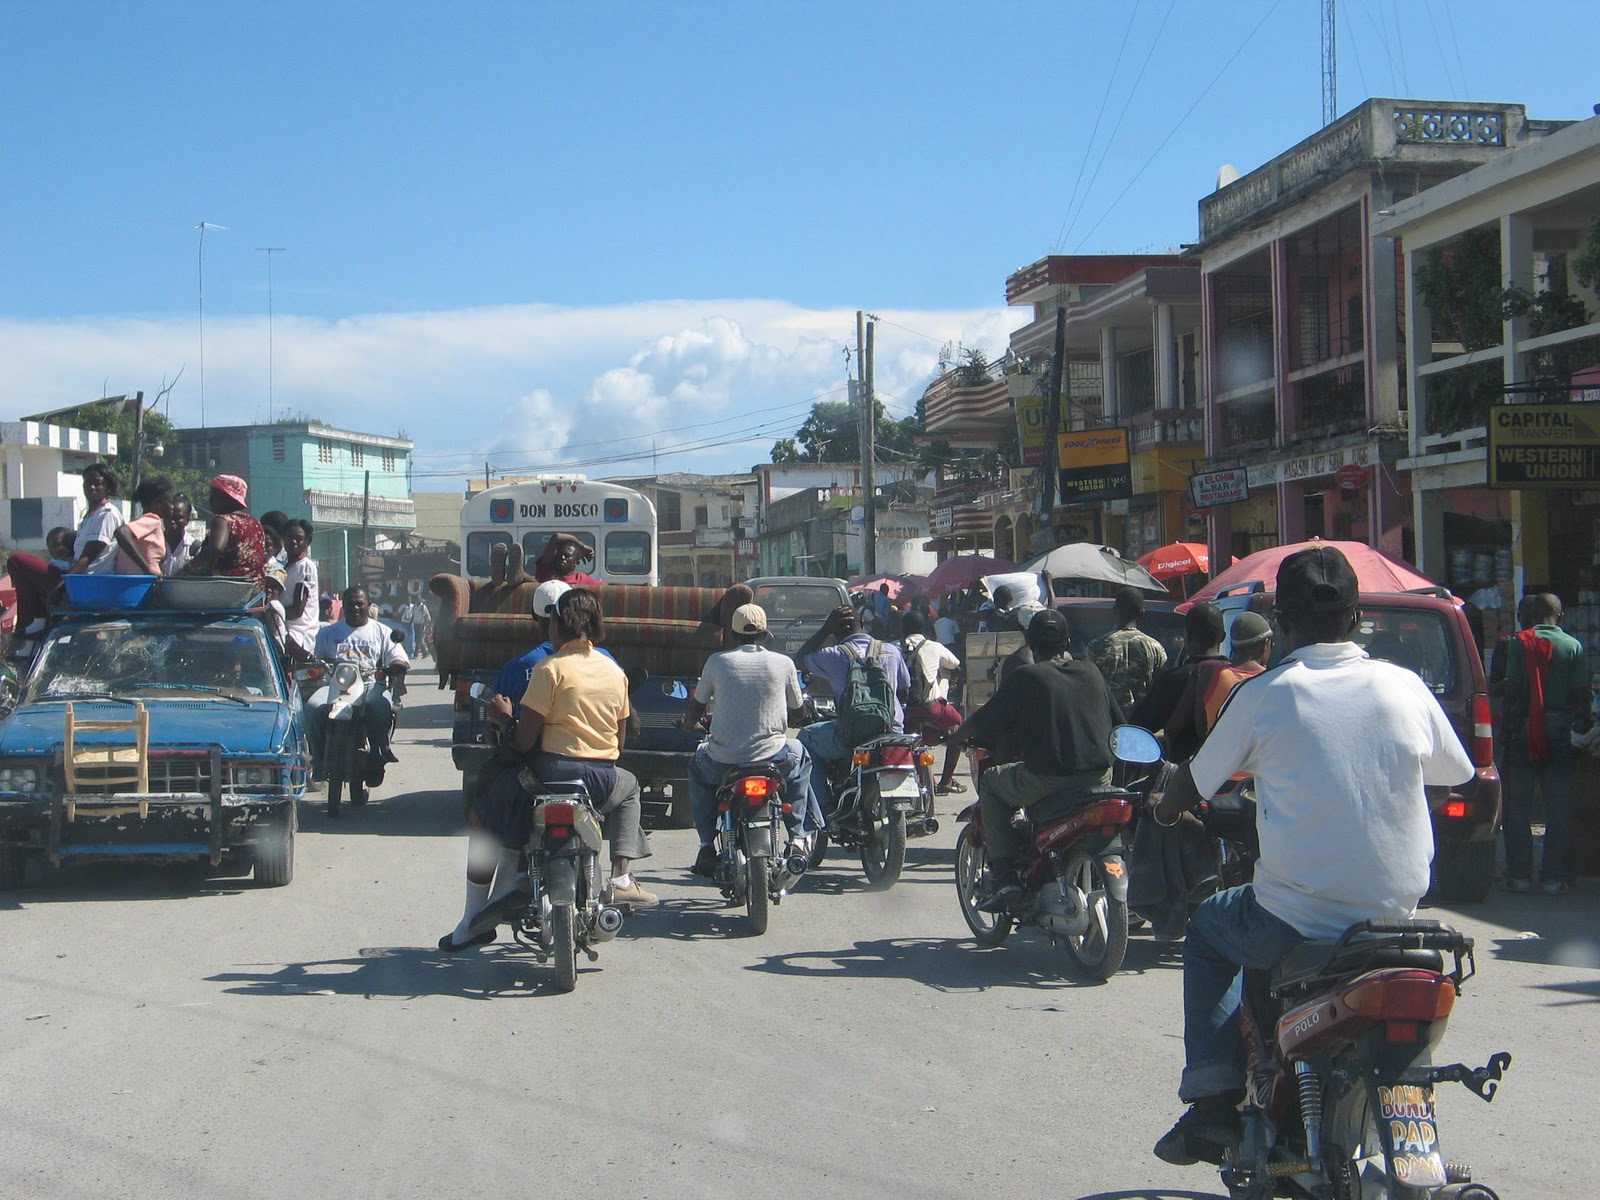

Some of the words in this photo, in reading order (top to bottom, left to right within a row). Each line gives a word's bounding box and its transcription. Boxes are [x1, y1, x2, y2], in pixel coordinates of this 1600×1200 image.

[1497, 412, 1574, 428] CAPITAL
[1511, 428, 1574, 439] TRANSFERT
[1499, 447, 1584, 463] WESTERN
[1525, 463, 1584, 479] UNION
[1066, 479, 1105, 488] WESTERN
[1078, 484, 1105, 492] UNION
[1211, 482, 1230, 492] BAR
[520, 503, 547, 518] DON
[553, 503, 599, 518] BOSCO
[1157, 557, 1192, 570] Digicel
[1294, 1012, 1320, 1037] POLO
[1389, 1120, 1436, 1154] PAP
